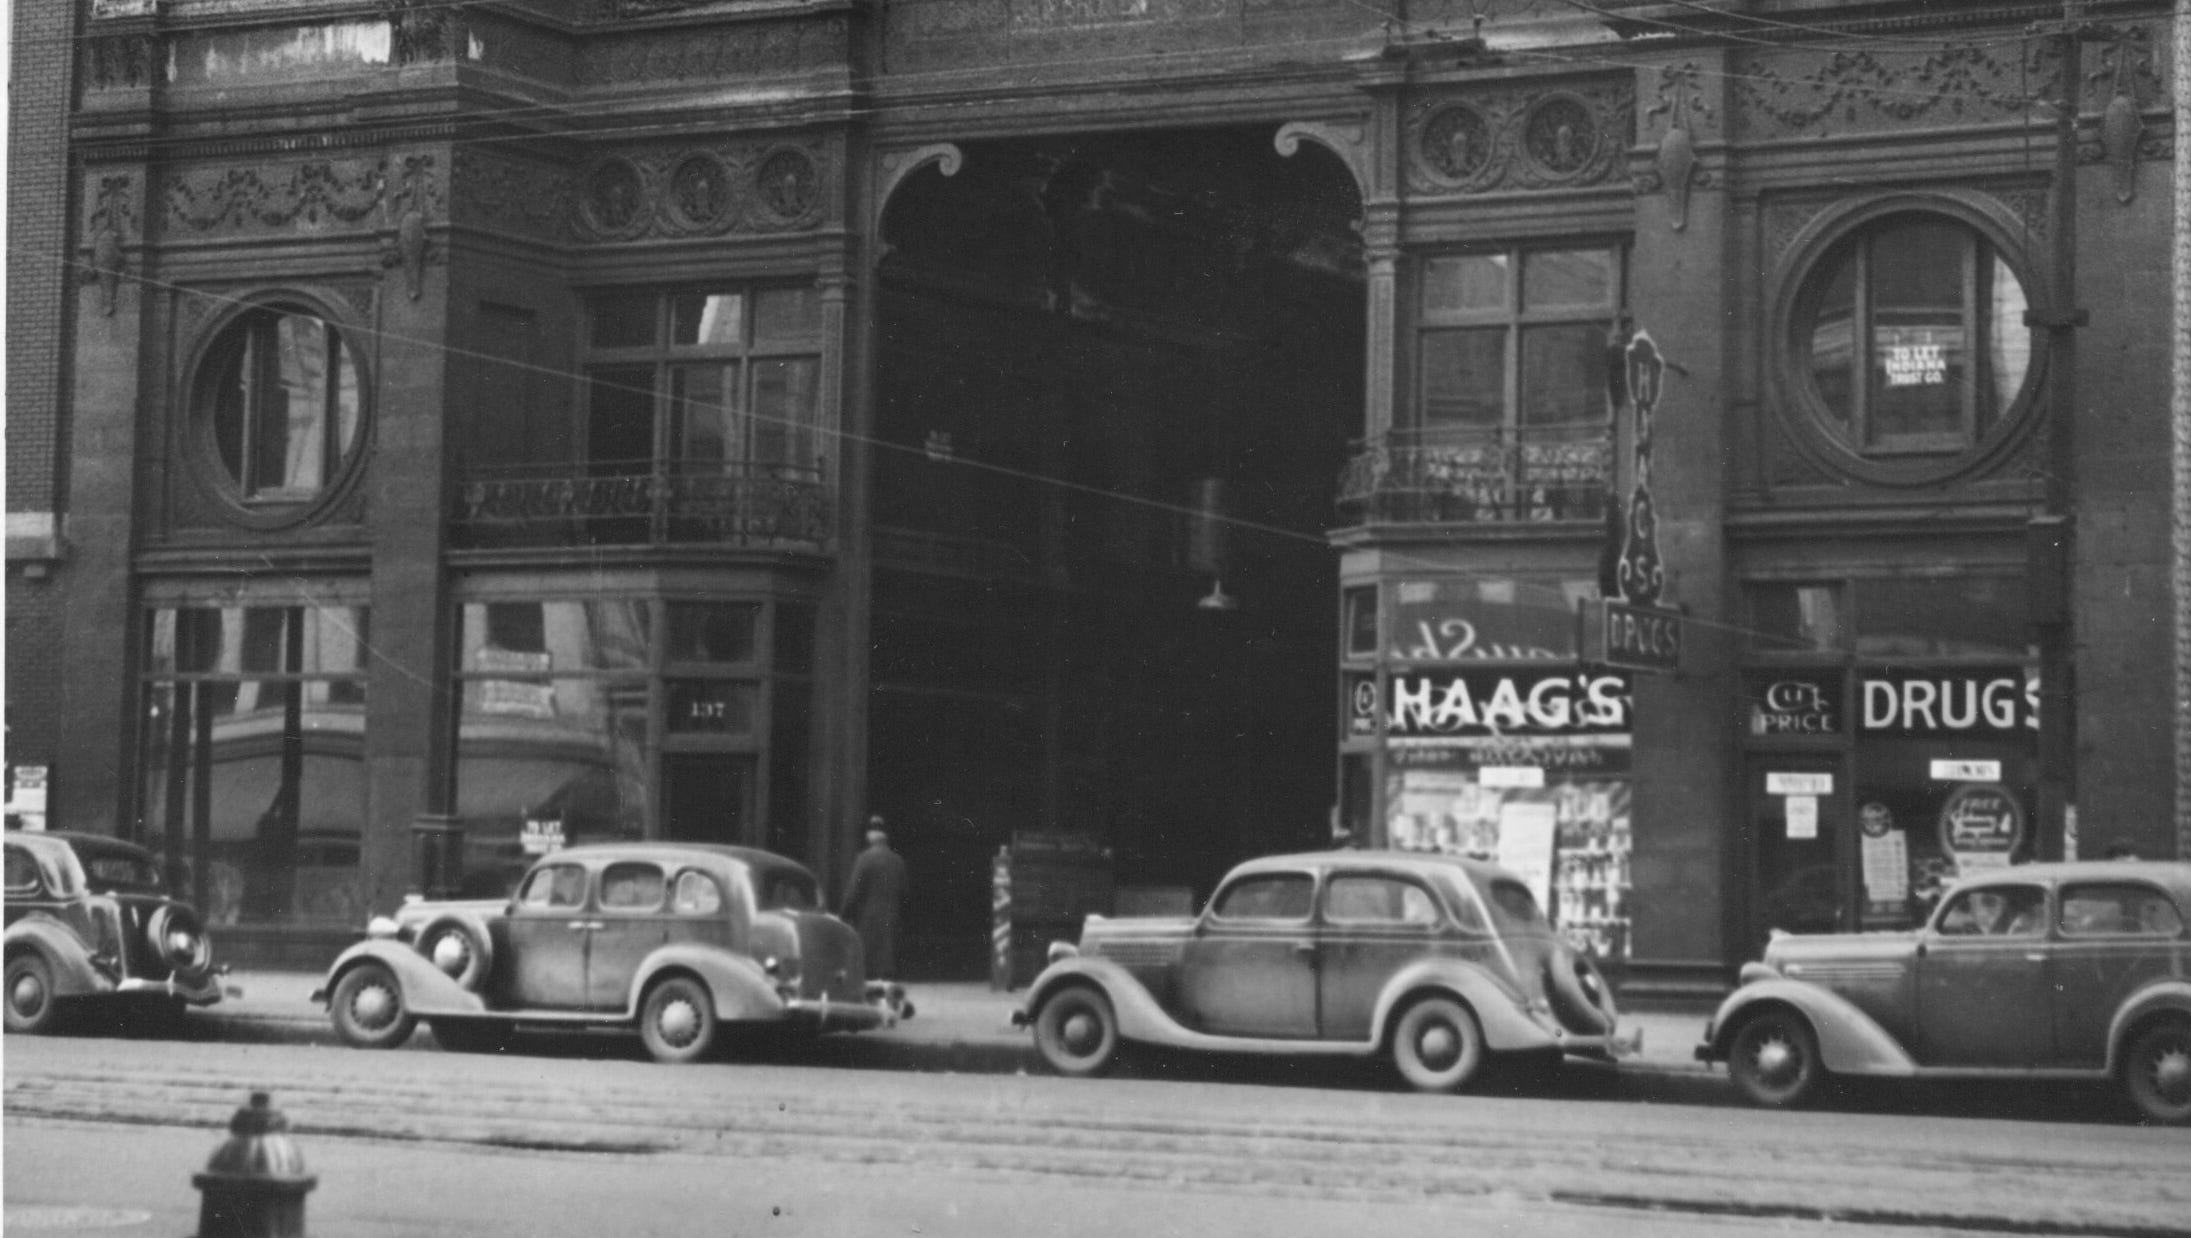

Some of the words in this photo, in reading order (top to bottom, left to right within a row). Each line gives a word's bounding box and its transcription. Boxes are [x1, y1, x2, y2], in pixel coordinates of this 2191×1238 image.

[1893, 346, 1910, 361] TO
[1914, 345, 1939, 360] LET
[1886, 359, 1946, 374] INDIANA
[1610, 612, 1677, 656] DRUGS
[1393, 674, 1625, 727] HAAG'S
[691, 702, 725, 718] 137
[1760, 713, 1833, 731] PRICE
